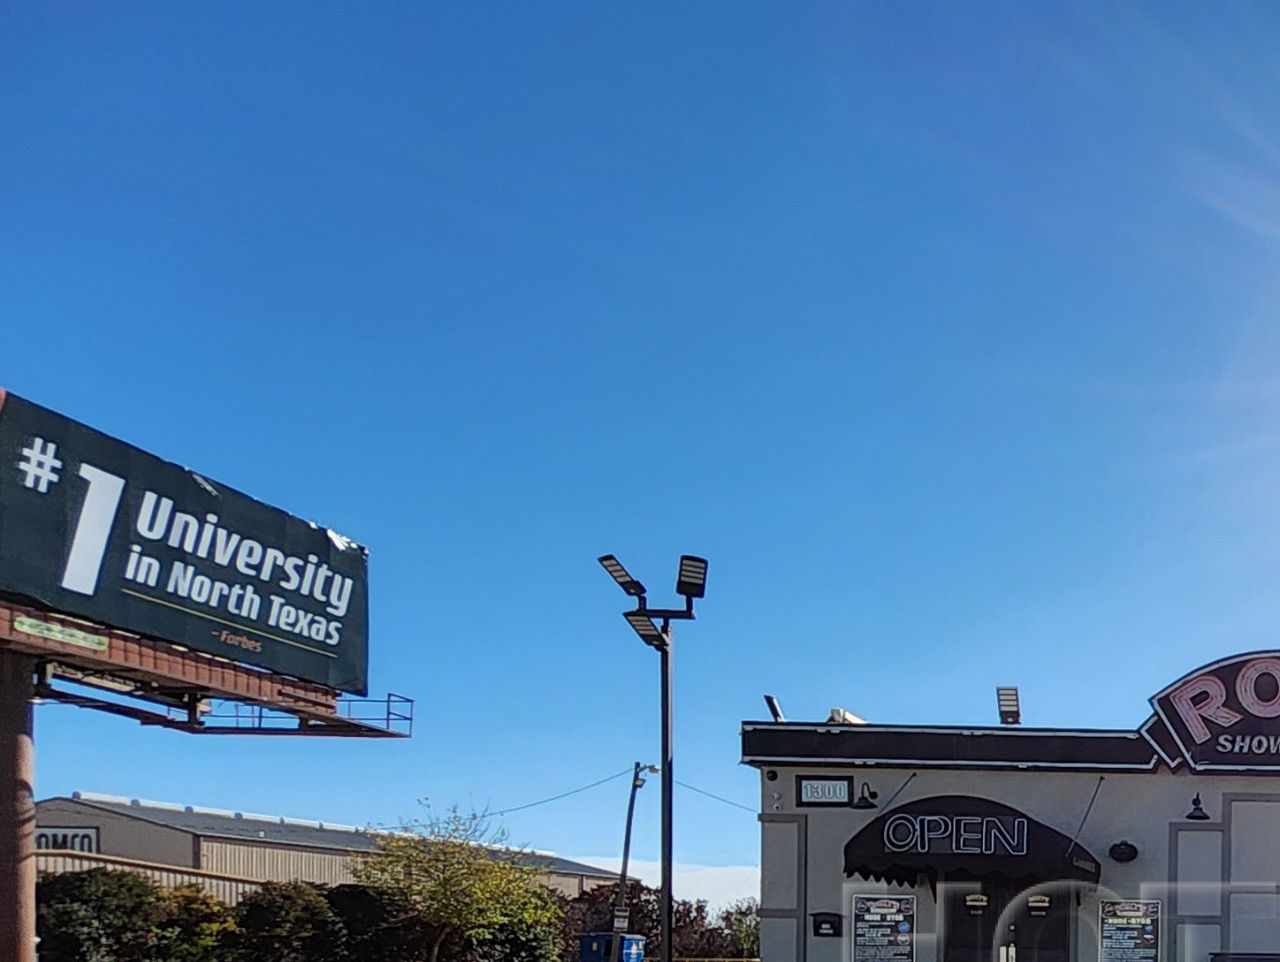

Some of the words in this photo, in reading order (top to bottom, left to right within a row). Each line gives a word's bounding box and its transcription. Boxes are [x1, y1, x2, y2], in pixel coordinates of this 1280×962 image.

[136, 491, 354, 617] University
[124, 544, 161, 586] in
[166, 561, 261, 620] North
[267, 594, 343, 646] Texas
[804, 783, 846, 799] 1300
[884, 813, 1027, 855] OPEN
